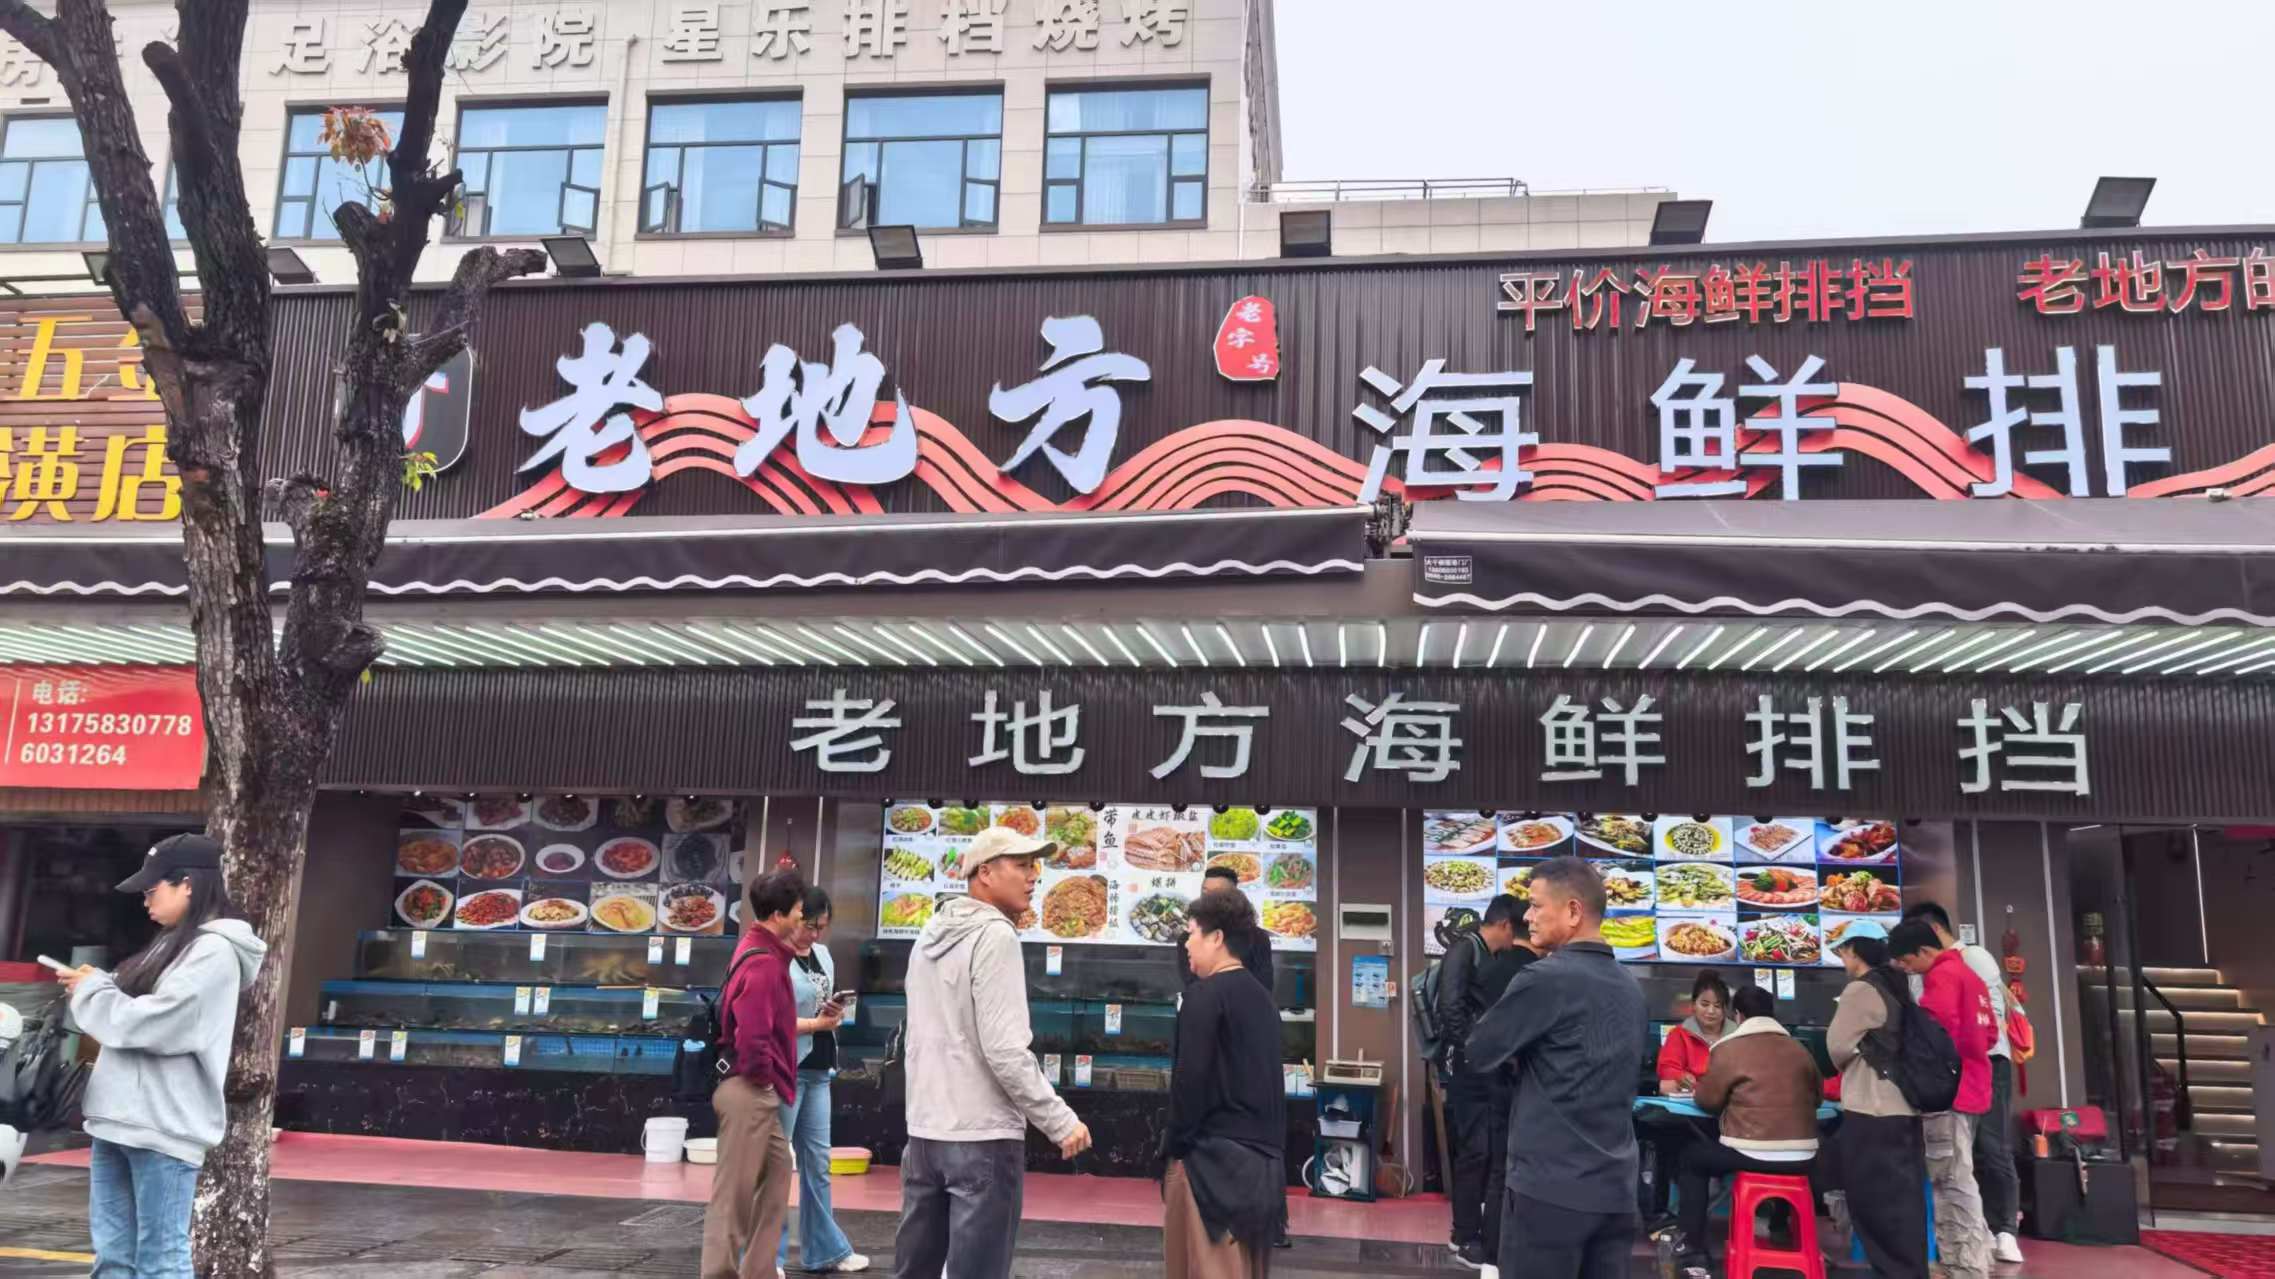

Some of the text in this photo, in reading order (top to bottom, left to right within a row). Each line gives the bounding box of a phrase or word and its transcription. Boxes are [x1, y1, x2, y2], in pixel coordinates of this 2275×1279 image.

[1497, 260, 1914, 330] 平价海鲜排挡
[1226, 301, 1275, 375] 老字号
[516, 314, 2173, 505] 老地方 海鲜排
[21, 743, 126, 766] 6031264
[28, 712, 192, 736] 13175830778
[790, 688, 2091, 796] 老地方海鲜排挡
[1103, 808, 1119, 849] 带鱼
